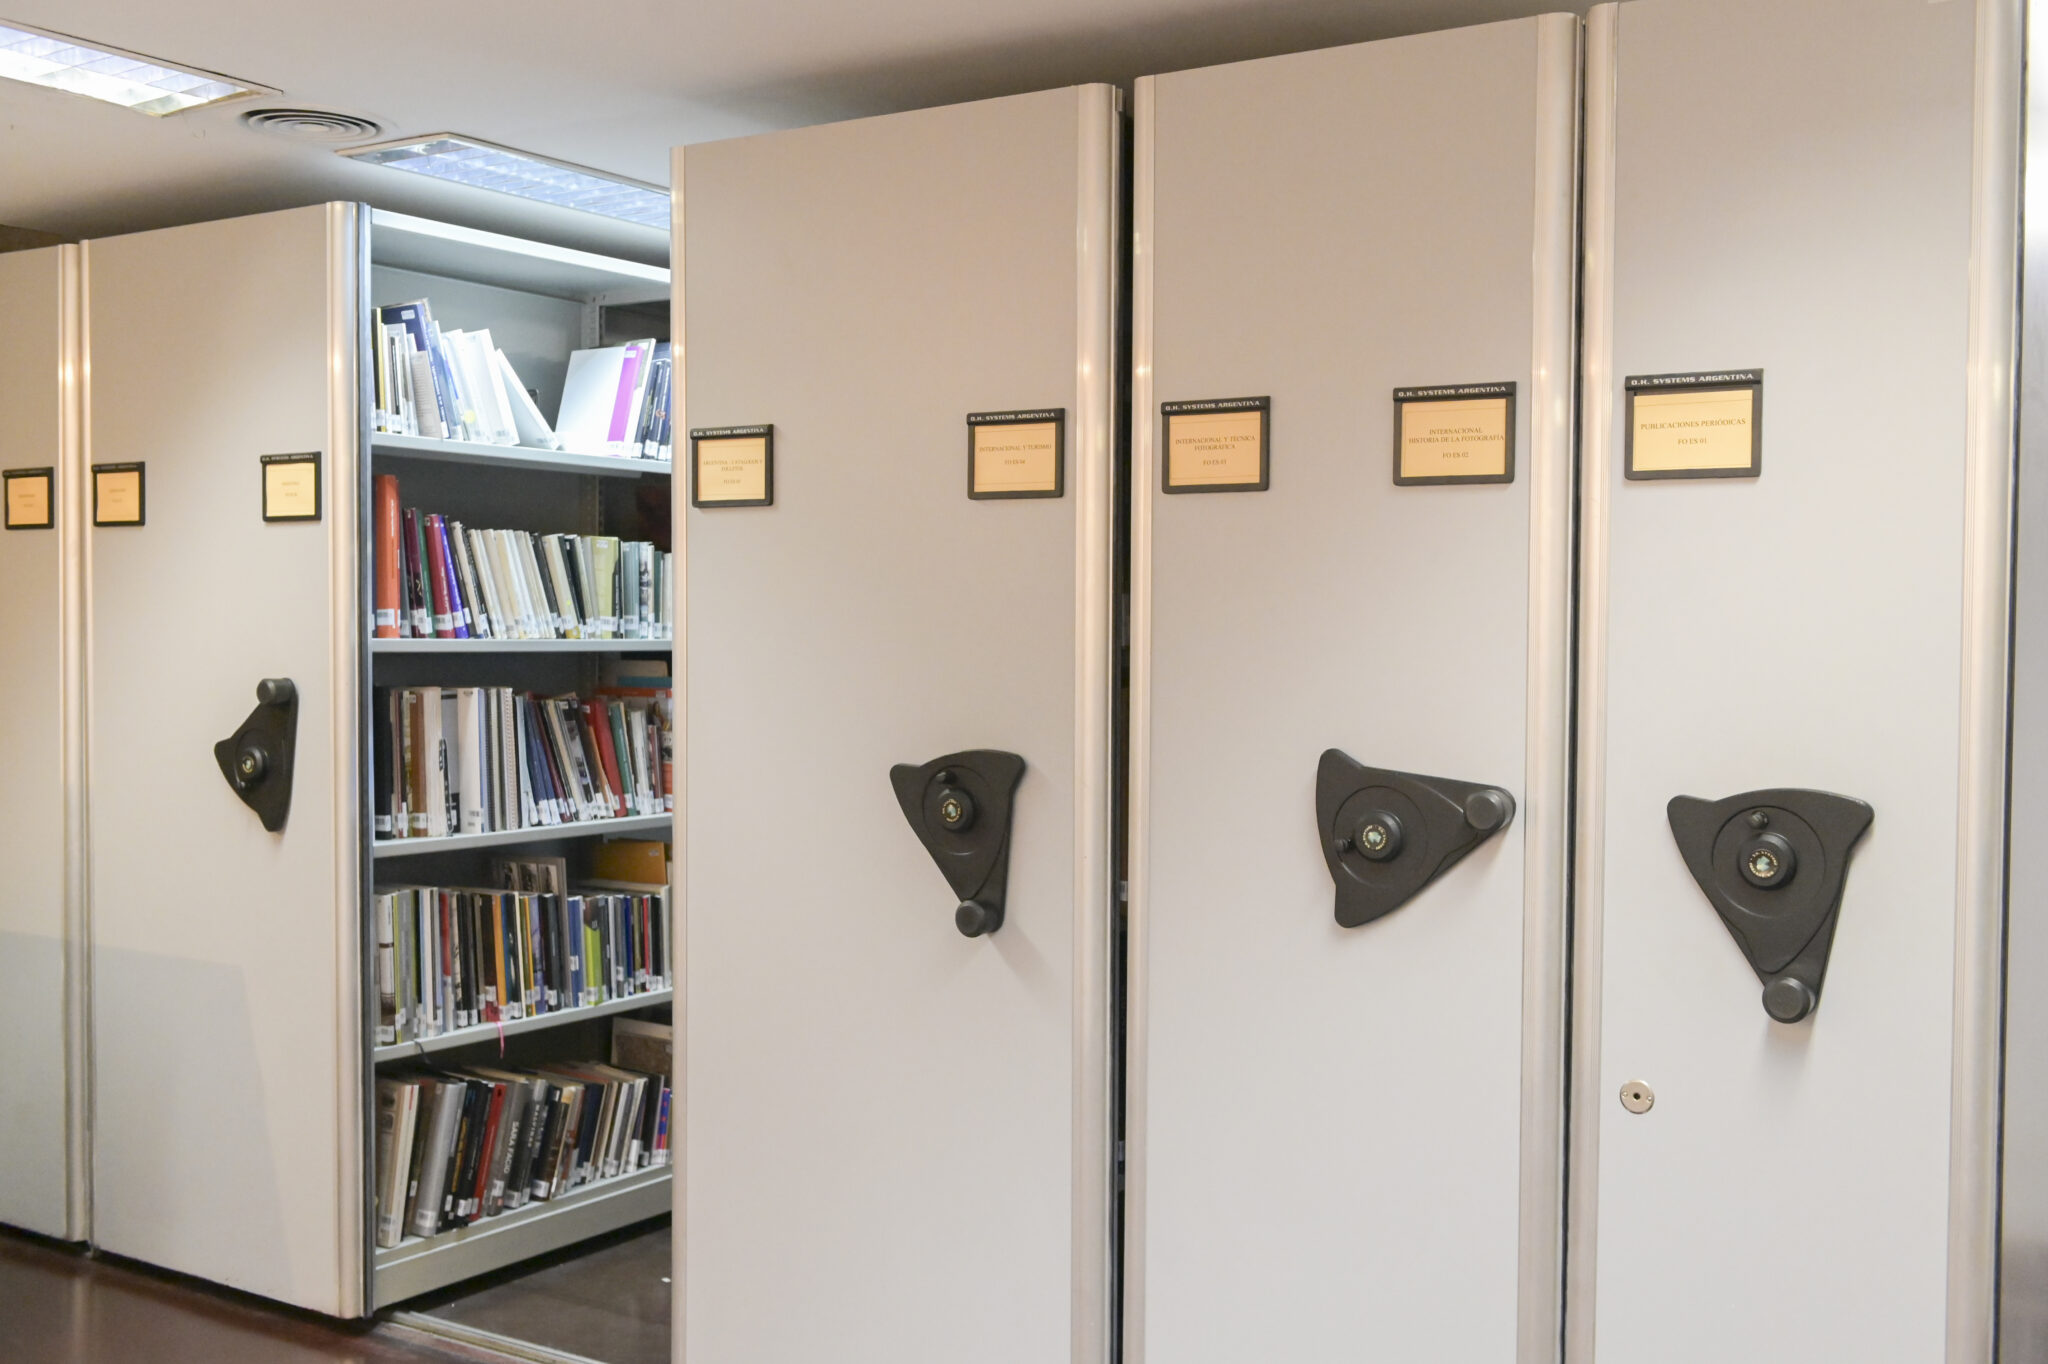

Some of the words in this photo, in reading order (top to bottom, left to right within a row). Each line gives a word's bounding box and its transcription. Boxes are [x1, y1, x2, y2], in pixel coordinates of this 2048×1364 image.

[1653, 376, 1696, 384] SYSTEMS
[1698, 373, 1754, 382] ARGENTINA
[1458, 386, 1506, 394] ARGENTINA
[1640, 420, 1700, 430] PUBLICACIONES
[1430, 427, 1483, 435] INTERNACIONAL
[508, 1121, 520, 1146] SARA
[504, 1147, 514, 1174] FACIO
